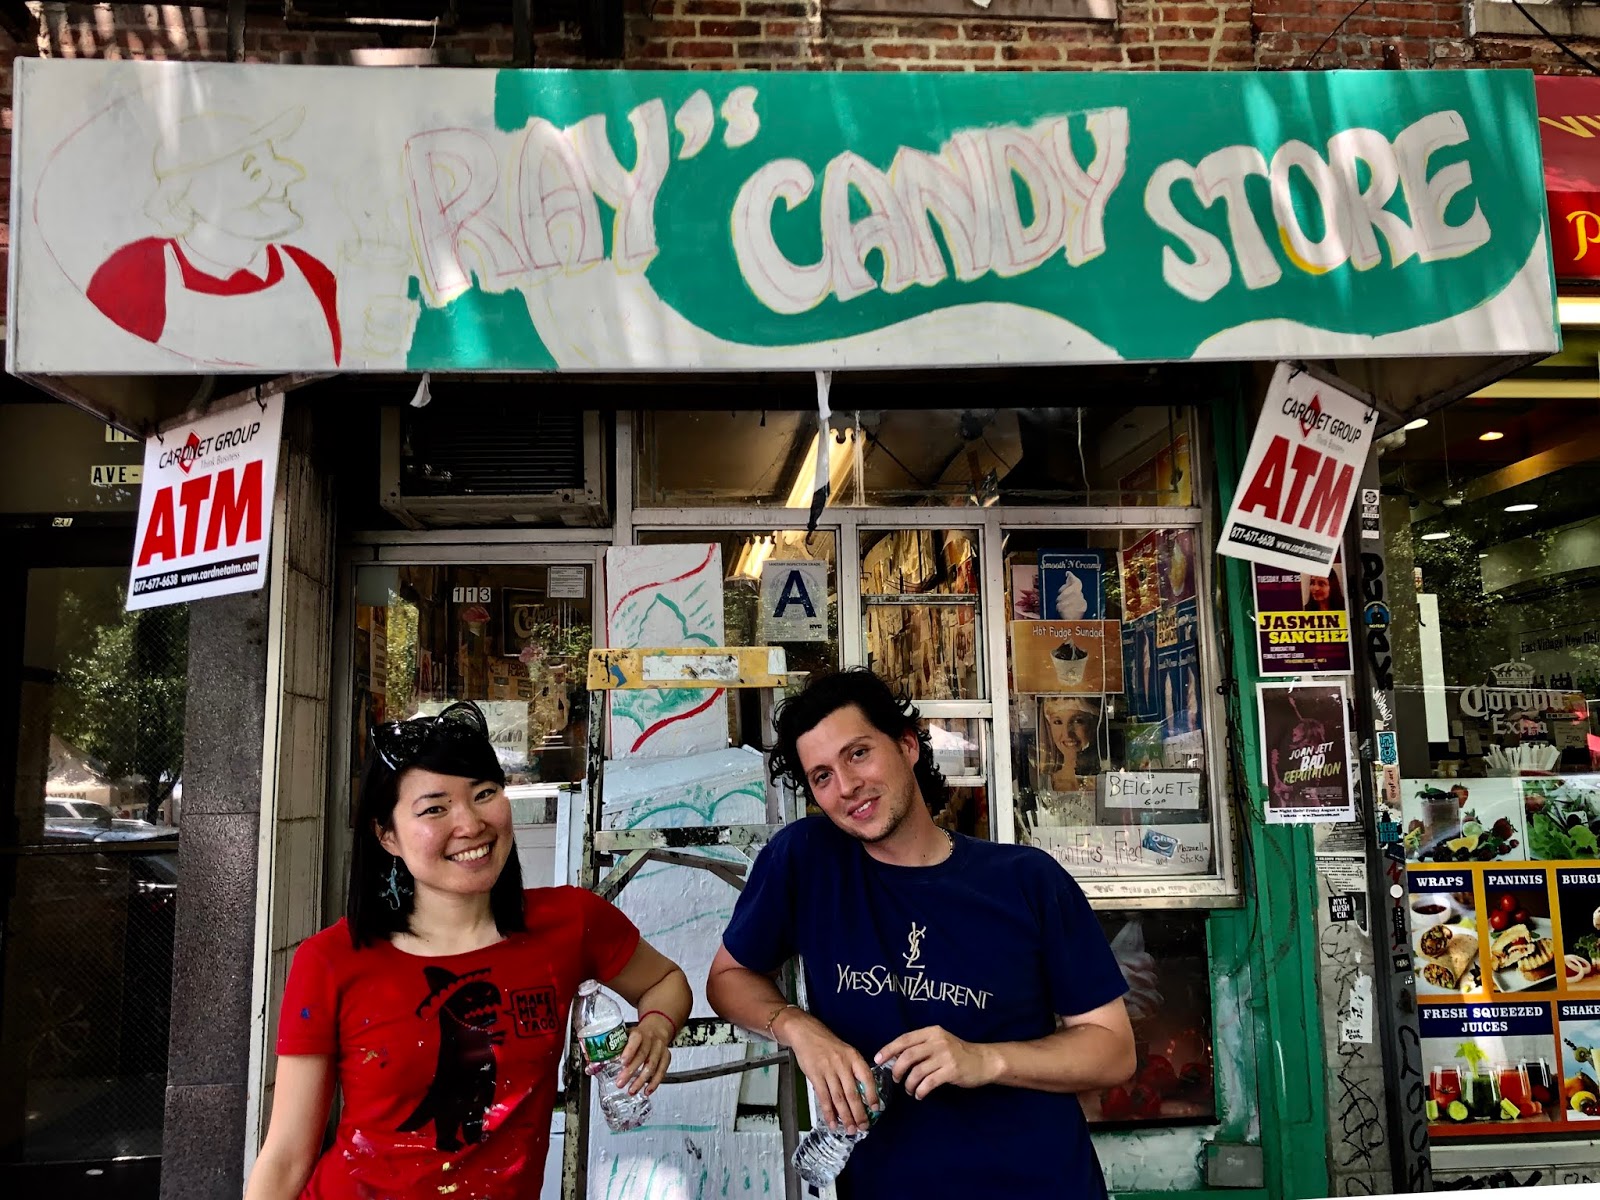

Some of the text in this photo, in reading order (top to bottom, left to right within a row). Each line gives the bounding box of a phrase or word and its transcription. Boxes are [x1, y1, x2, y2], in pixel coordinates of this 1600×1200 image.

[731, 106, 1129, 316] CANDY
[1144, 110, 1492, 302] STORE
[1329, 418, 1362, 444] GROUP
[159, 421, 261, 470] CARDNET GROUP
[1237, 434, 1356, 539] ATM
[136, 459, 264, 568] ATM
[1075, 559, 1102, 571] Creamy
[133, 559, 259, 593] 877-677-6638 www.cardnetatm.com
[454, 587, 491, 602] 113
[772, 570, 817, 618] A
[1260, 614, 1340, 630] JASMIN
[1033, 626, 1047, 636] Hot
[1049, 627, 1073, 640] Fudge
[1269, 630, 1349, 644] SANCHEZ
[1521, 641, 1536, 653] East
[1537, 638, 1563, 652] Village
[1460, 683, 1566, 721] Corona
[1491, 713, 1549, 735] Extra
[1288, 741, 1335, 760] JOAN JETT
[1300, 753, 1326, 771] BAD
[1283, 761, 1342, 784] REPUTATION
[1115, 828, 1143, 865] Fried
[1151, 833, 1178, 846] OREO
[1416, 876, 1464, 887] WRAPS
[1487, 875, 1543, 886] PANINIS
[1332, 897, 1348, 905] NYC
[516, 991, 551, 1005] MAKE
[518, 1005, 554, 1019] ME A
[1423, 1006, 1543, 1019] FRESH SQUEEZED
[1562, 1004, 1600, 1016] SHAKE
[522, 1018, 556, 1032] TACO
[1461, 1021, 1508, 1033] JUICES
